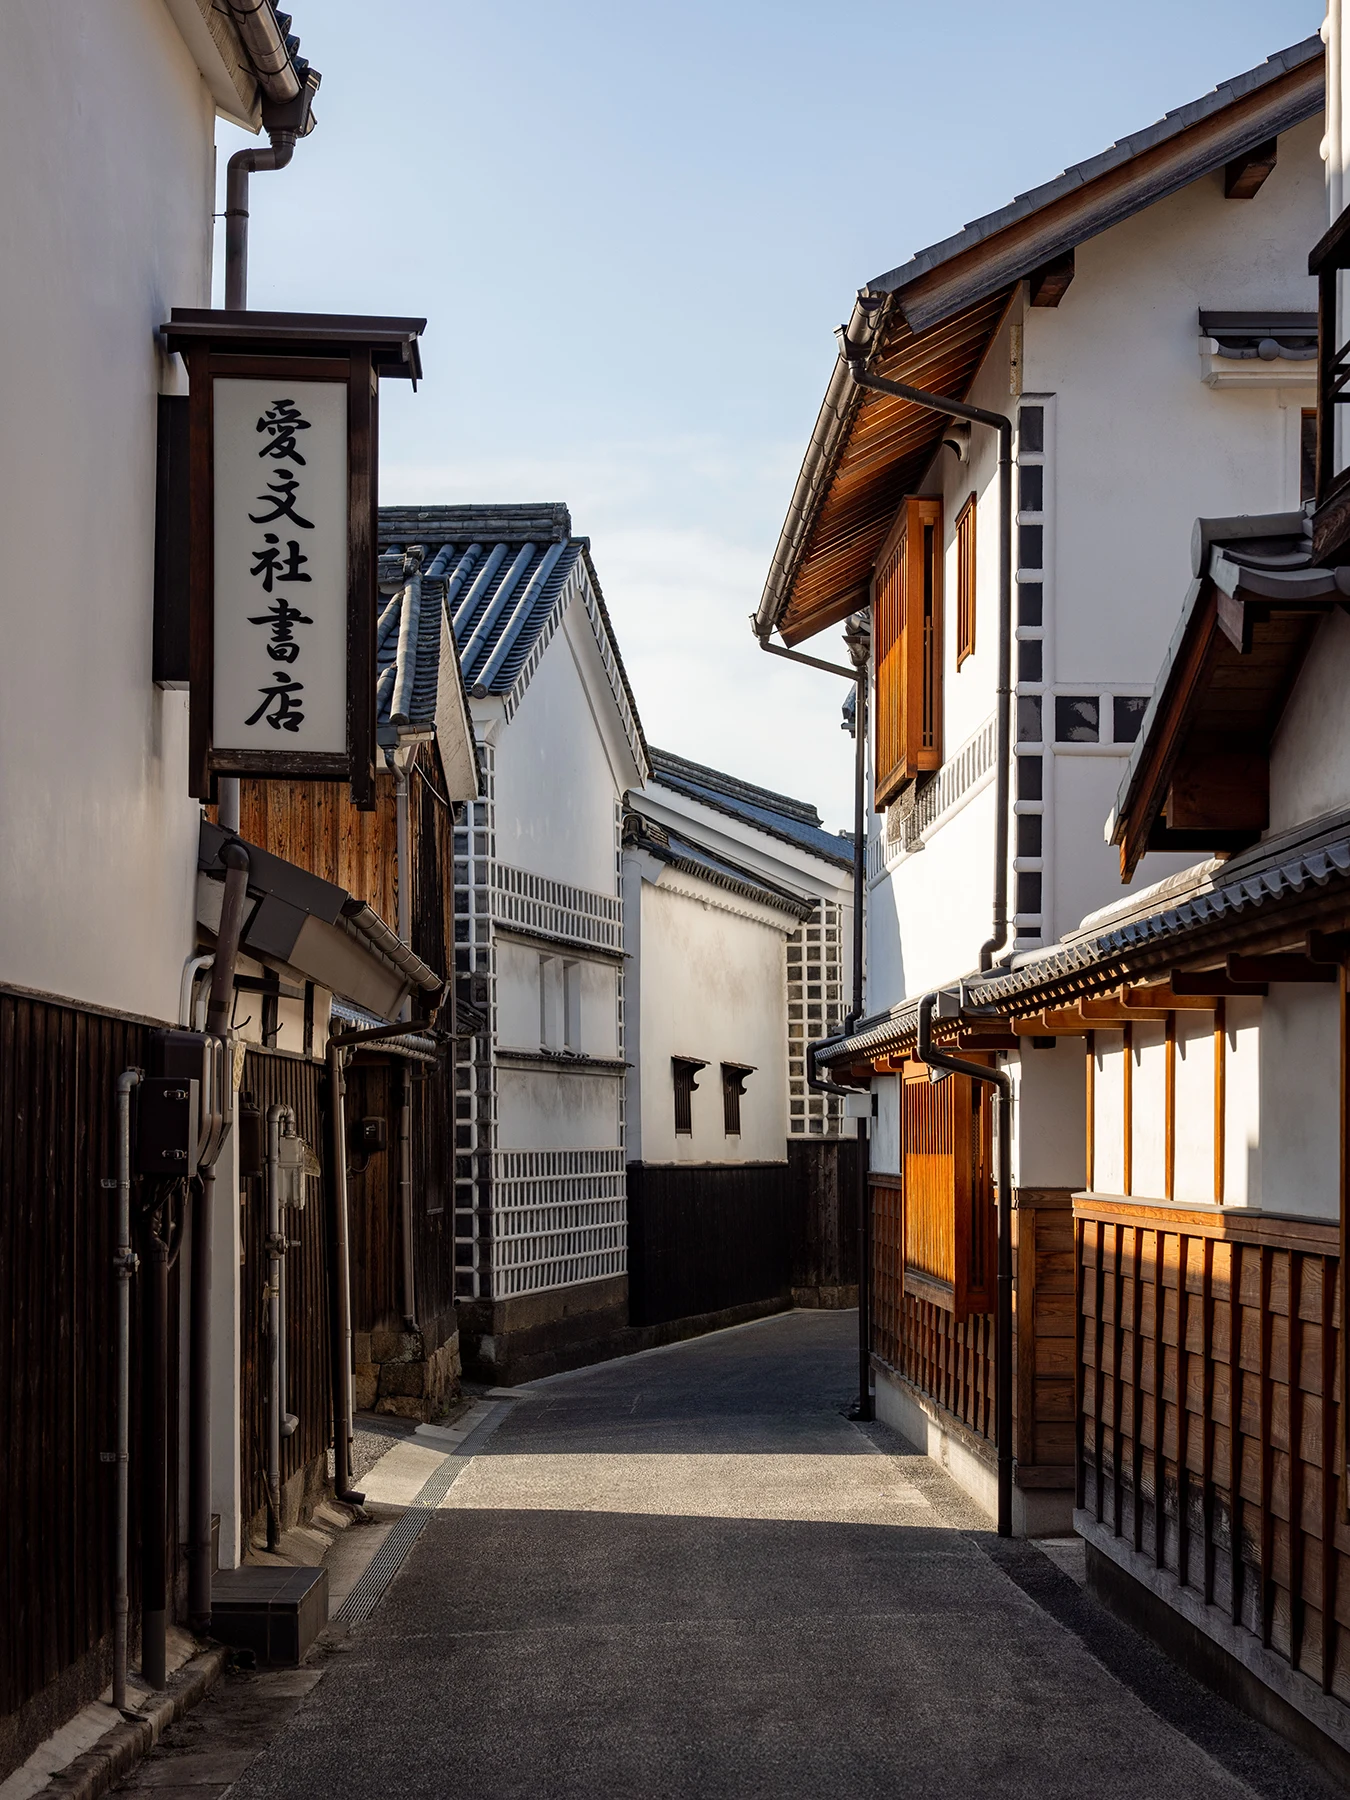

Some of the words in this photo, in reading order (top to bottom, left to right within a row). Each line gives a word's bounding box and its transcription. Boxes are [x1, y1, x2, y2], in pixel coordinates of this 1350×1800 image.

[244, 399, 315, 732] 愛文社書店
